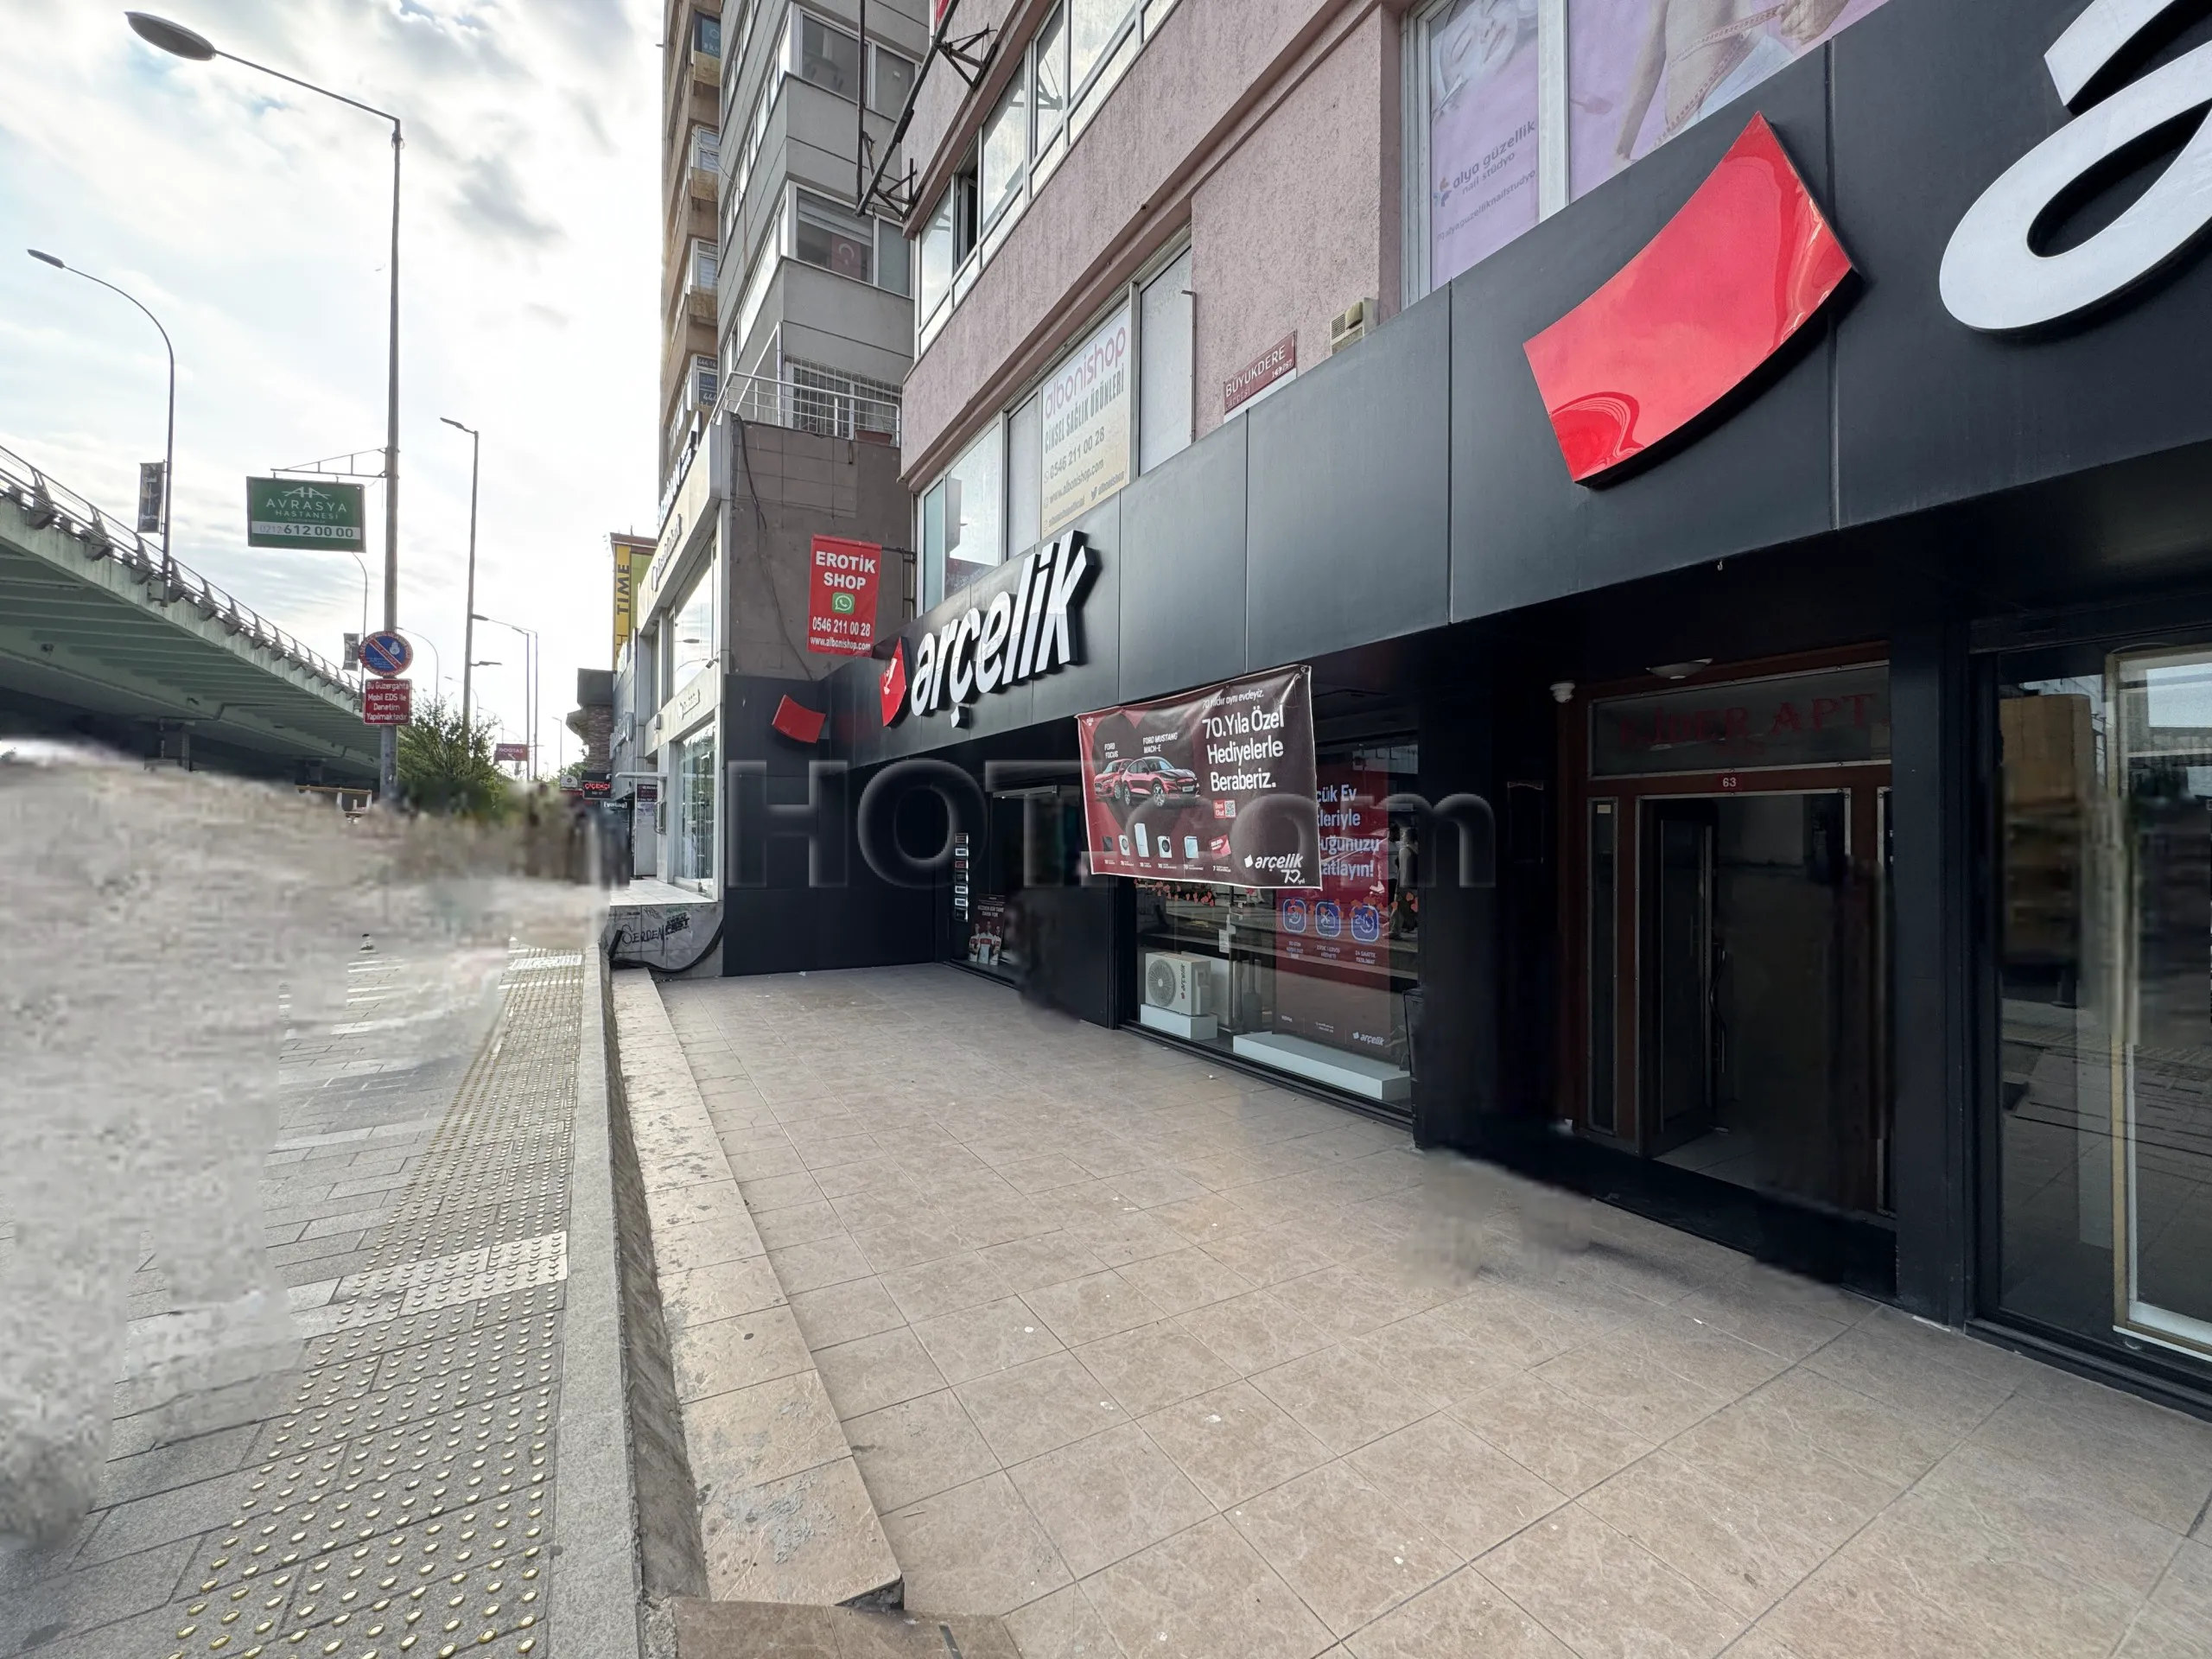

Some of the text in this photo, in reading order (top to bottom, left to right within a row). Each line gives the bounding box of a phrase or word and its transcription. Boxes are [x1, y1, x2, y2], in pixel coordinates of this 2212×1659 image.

[1453, 120, 1535, 188] alya güzellik
[1462, 176, 1479, 195] nail
[1045, 327, 1126, 419] albonishop
[1225, 344, 1286, 397] BÜYÜKDERE
[1050, 426, 1105, 480] 0546 211 00 28
[266, 498, 346, 512] AVRASYA
[275, 510, 339, 519] HASTANESİ
[283, 524, 311, 536] 612
[315, 526, 333, 537] 00
[335, 528, 353, 537] 00
[816, 550, 876, 574] EROTİK
[617, 564, 630, 615] TIME
[823, 572, 867, 590] SHOP
[812, 616, 871, 637] 0546 211 00 28
[911, 530, 1087, 728] arçelik
[810, 636, 871, 651] www.albonishop.com
[1202, 705, 1285, 739] 70.Yıla Özel
[1104, 742, 1116, 751] FORD
[1142, 732, 1179, 745] FORD MUSTANG
[1143, 744, 1161, 754] MACH-E
[1206, 734, 1284, 766] Hediyelerle
[1210, 767, 1277, 792] Beraberiz.
[1722, 777, 1737, 787] 63
[1341, 784, 1357, 803] Ev
[1319, 835, 1381, 855] uğunuzu
[1254, 853, 1304, 872] arçelik
[1360, 1033, 1385, 1046] arçelik
